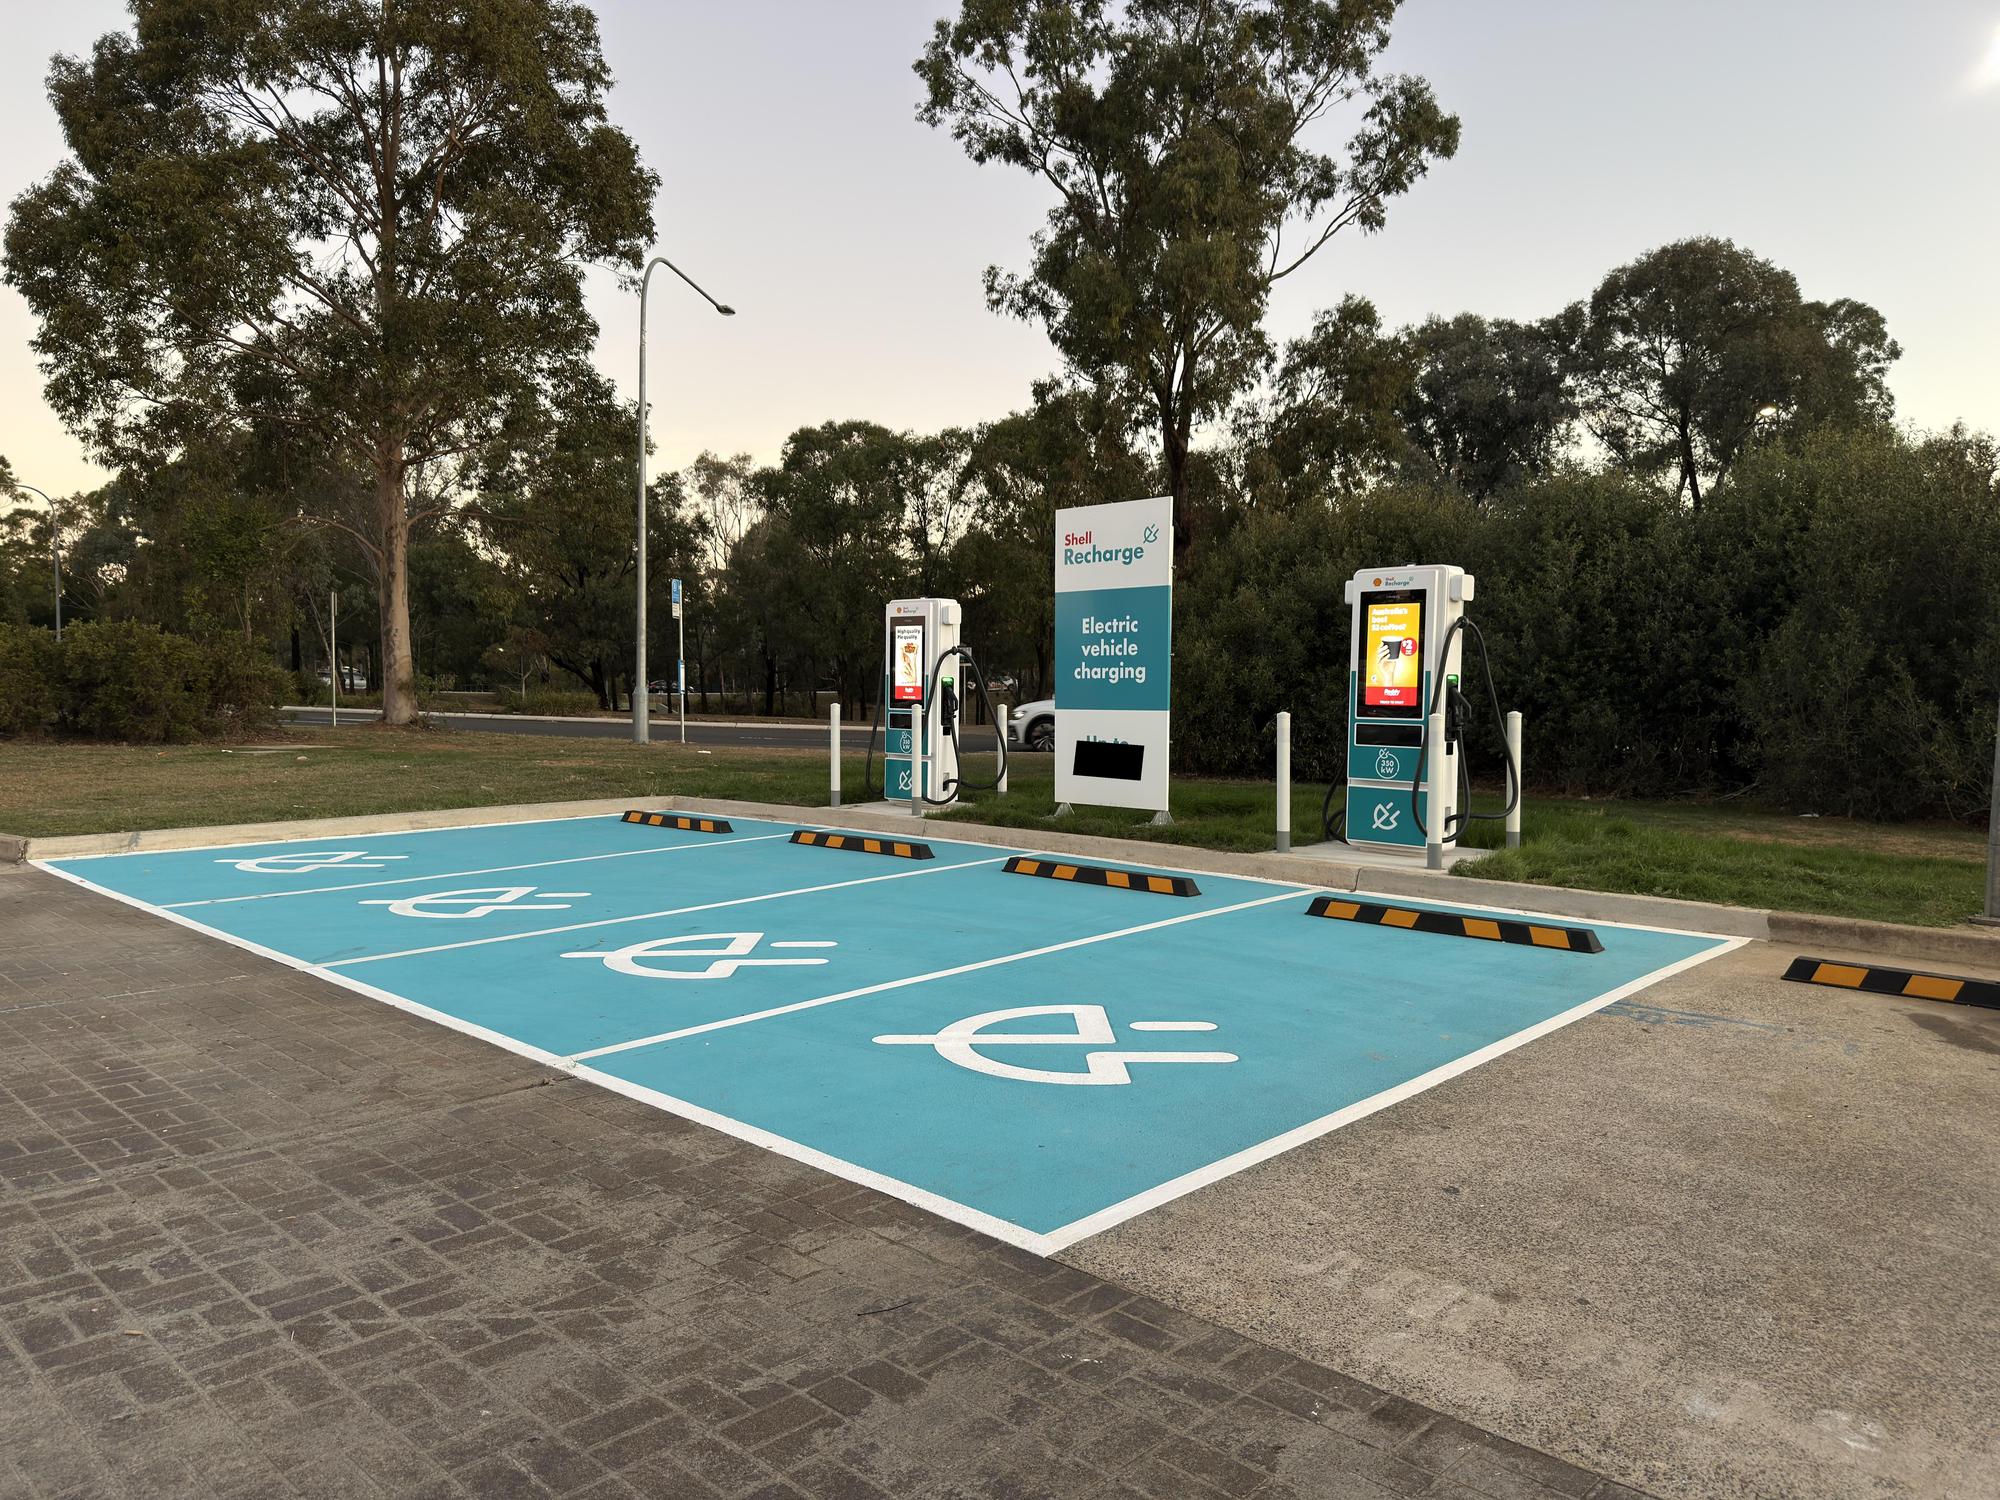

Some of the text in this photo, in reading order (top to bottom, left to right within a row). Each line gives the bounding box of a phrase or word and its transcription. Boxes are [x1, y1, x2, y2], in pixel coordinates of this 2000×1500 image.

[1064, 531, 1092, 546] Shell
[1064, 544, 1144, 566] Recharge
[1082, 615, 1138, 634] Electric
[1081, 638, 1138, 656] vehicle
[1074, 661, 1146, 684] charging
[1380, 766, 1394, 774] kW
